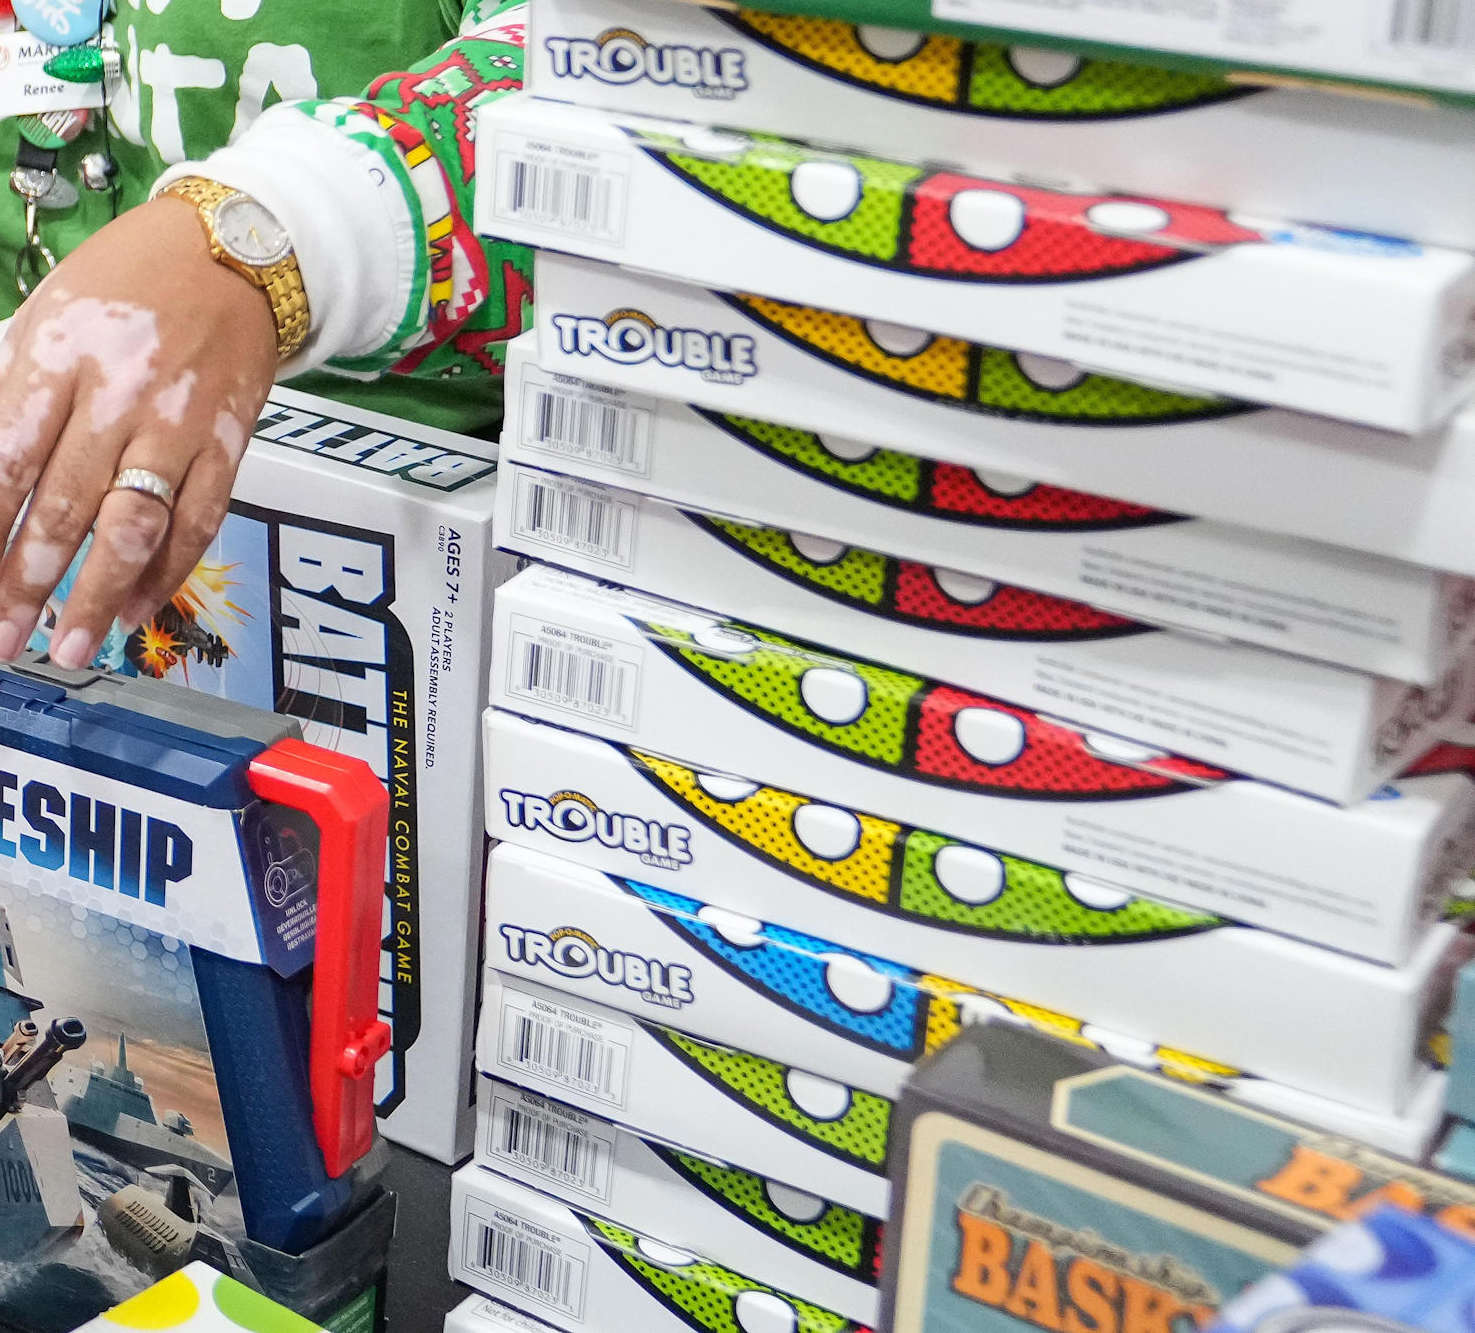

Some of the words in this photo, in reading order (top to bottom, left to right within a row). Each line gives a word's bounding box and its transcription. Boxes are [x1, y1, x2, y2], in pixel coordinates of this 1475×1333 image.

[545, 35, 750, 91] TROUBLE
[23, 83, 65, 96] Renee
[553, 314, 757, 377] TROUBLE
[702, 370, 744, 385] GAME
[438, 525, 446, 552] C3890
[446, 528, 461, 577] AGES
[446, 581, 458, 604] 7+
[432, 606, 442, 645] ADULT
[541, 625, 567, 640] A5064
[442, 623, 454, 672] PLAYERS
[428, 647, 440, 708] ASSEMBLY
[393, 690, 408, 724] THE
[425, 709, 437, 769] REQUIRED.
[392, 735, 410, 814] NAVAL
[499, 788, 693, 864] TROUBLE
[393, 820, 411, 913] COMBAT
[639, 854, 681, 871] GAME
[285, 898, 308, 917] UNLOCK
[396, 918, 412, 984] GAME
[499, 923, 694, 1003] TROUBLE
[532, 1001, 557, 1014] A5064
[641, 991, 682, 1009] GAME
[529, 1011, 553, 1024] PROOF
[525, 1060, 559, 1078] 30509
[517, 1103, 540, 1118] PROOF
[520, 1094, 546, 1108] A5064
[512, 1150, 547, 1170] 30509
[494, 1210, 518, 1227] A5064
[491, 1220, 513, 1234] PROOF
[514, 1230, 525, 1240] OF
[526, 1235, 562, 1257] PURCHASE
[488, 1268, 520, 1287] 30509
[483, 1303, 502, 1316] Not
[502, 1310, 515, 1322] for
